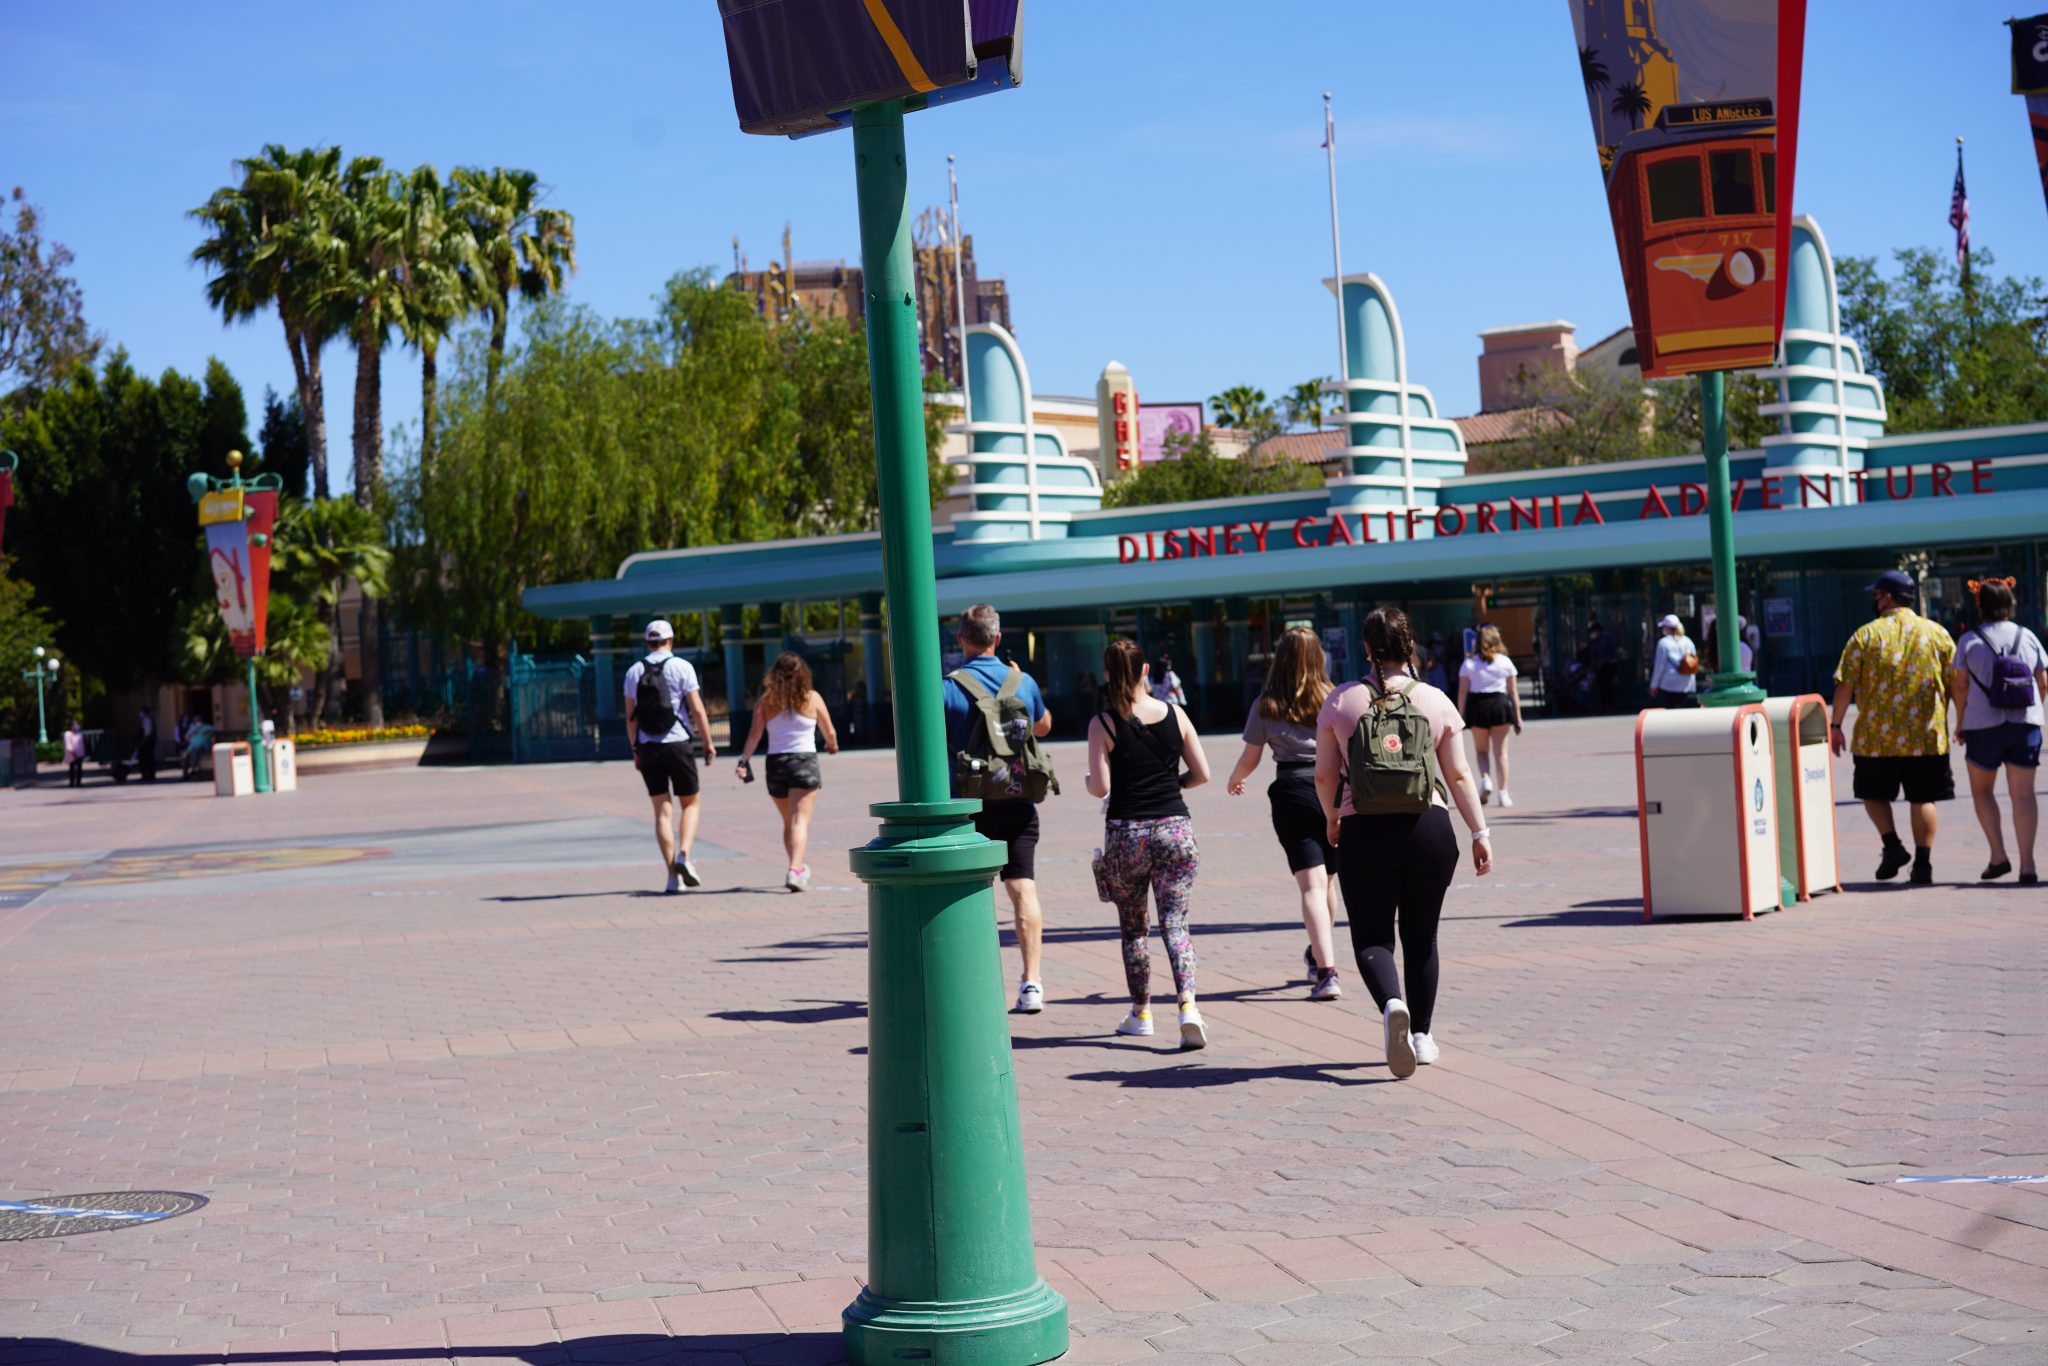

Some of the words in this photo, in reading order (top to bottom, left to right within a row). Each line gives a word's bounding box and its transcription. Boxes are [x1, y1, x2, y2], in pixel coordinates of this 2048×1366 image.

[1692, 107, 1712, 122] LOS
[1716, 103, 1761, 120] ANGELES
[1719, 231, 1753, 246] 717
[1118, 521, 1271, 564] DISNEY
[1293, 490, 1605, 548] CALIFORNIA
